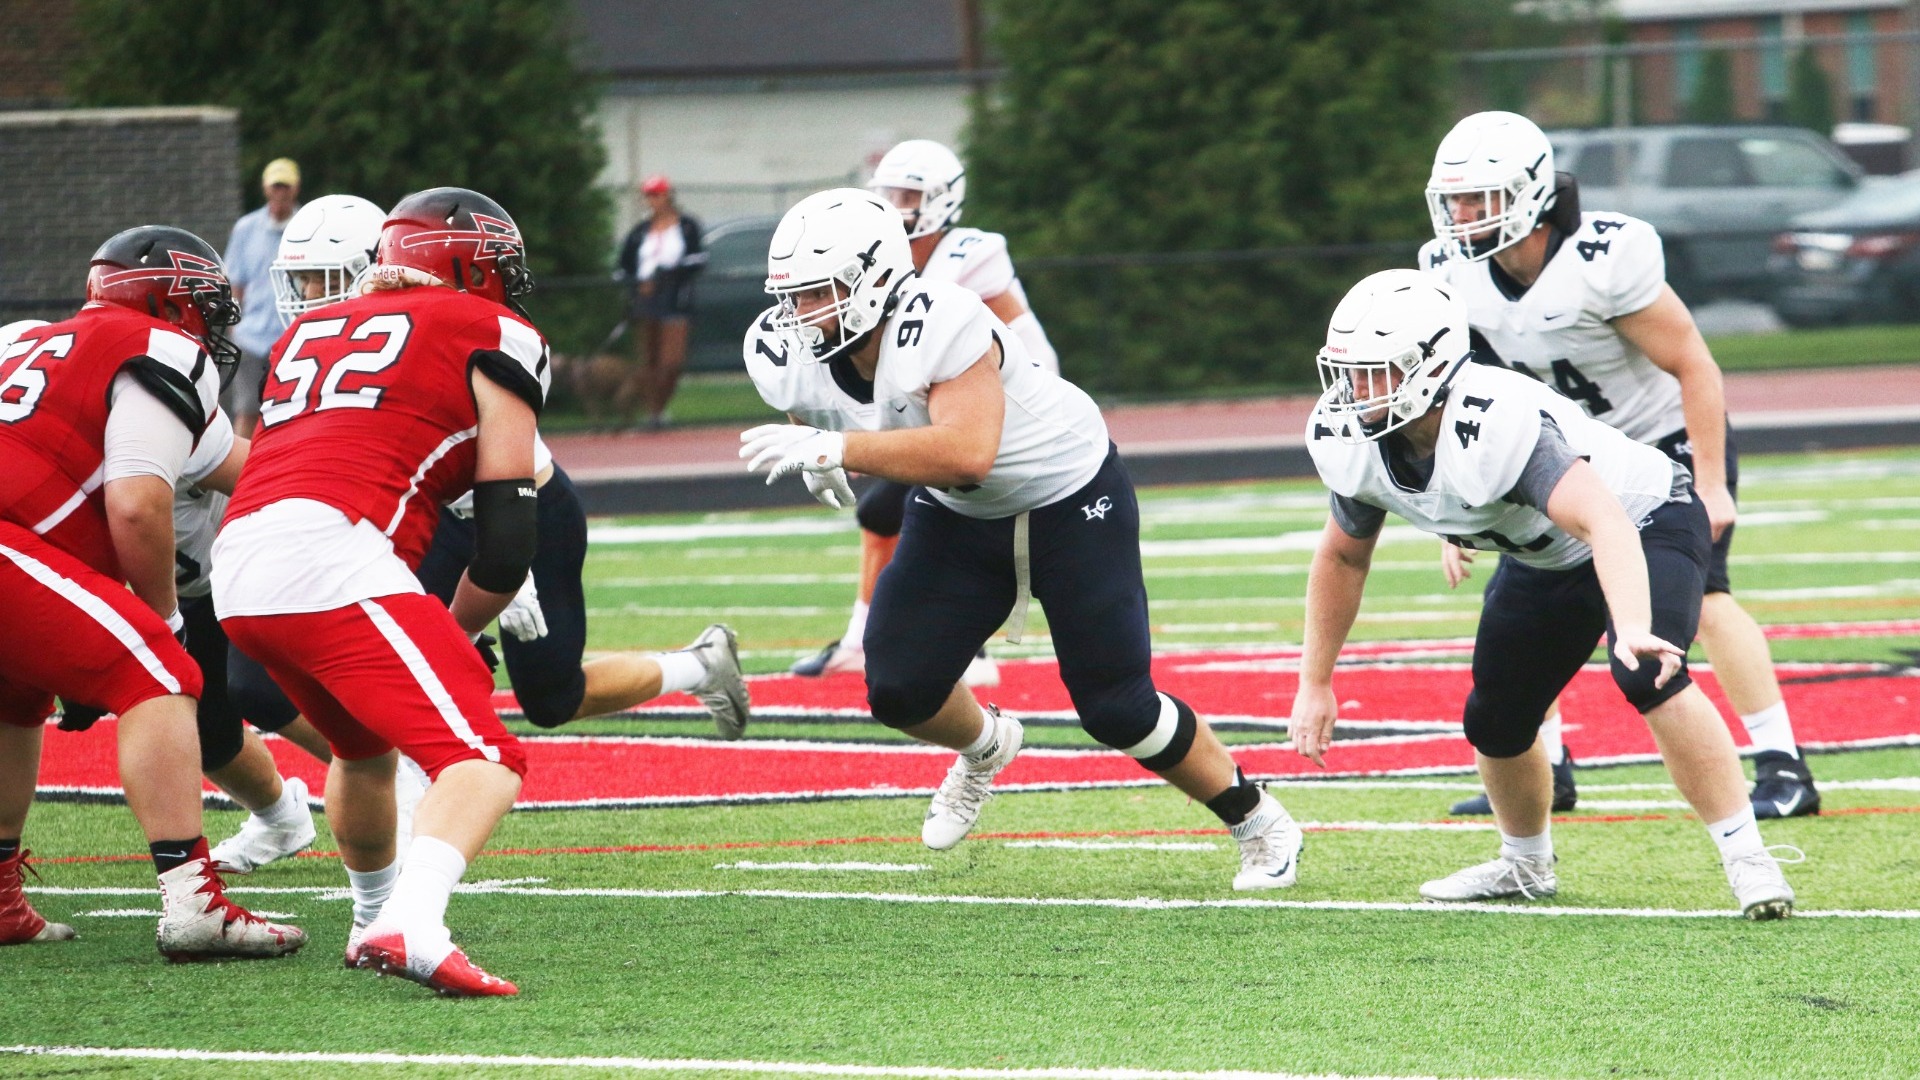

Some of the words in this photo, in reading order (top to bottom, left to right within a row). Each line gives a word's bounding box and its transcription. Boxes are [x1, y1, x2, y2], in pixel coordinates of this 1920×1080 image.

[1576, 219, 1627, 262] 44
[896, 292, 934, 348] 97
[259, 311, 415, 429] 52
[1454, 395, 1495, 450] 41
[981, 738, 1000, 761] NIKE
